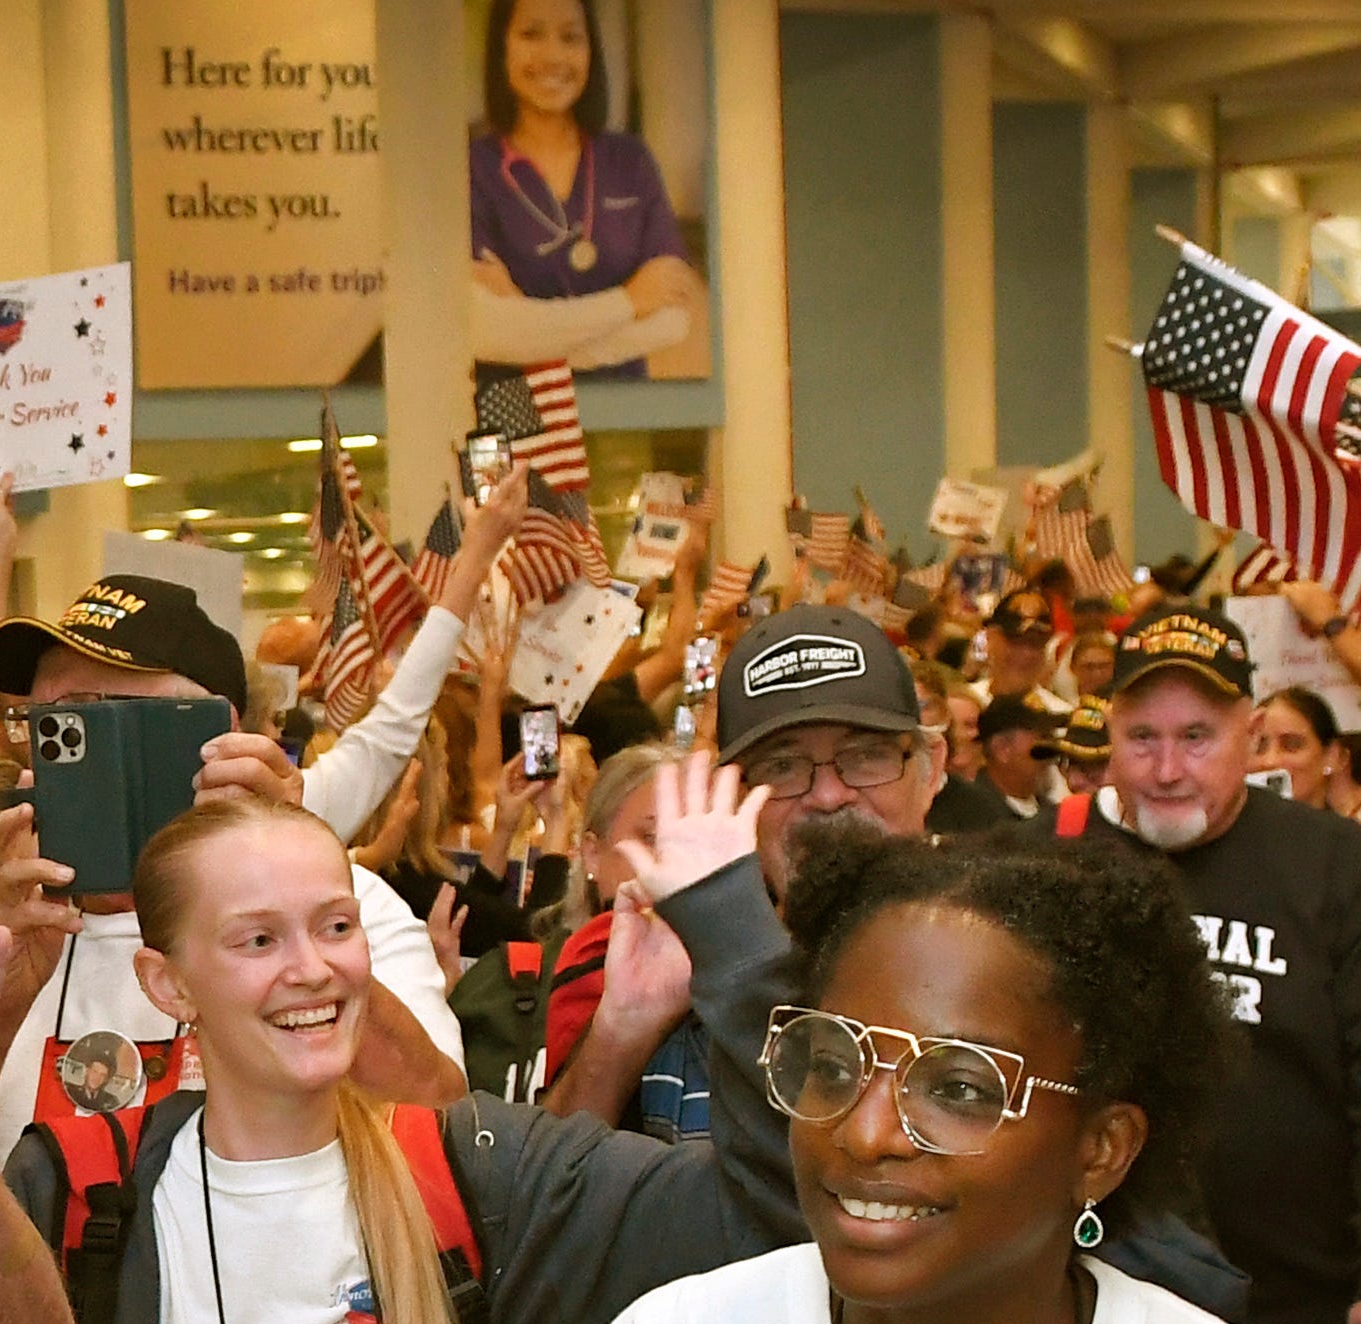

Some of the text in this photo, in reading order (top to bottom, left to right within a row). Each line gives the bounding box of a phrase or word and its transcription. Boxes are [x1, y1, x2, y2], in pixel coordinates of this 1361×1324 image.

[159, 46, 251, 88] Here
[261, 46, 313, 89] for
[161, 114, 324, 153] wherever
[166, 181, 342, 233] takes you.
[168, 268, 236, 294] Have
[244, 275, 260, 293] a
[268, 265, 322, 293] safe
[18, 362, 52, 387] You
[9, 399, 80, 427] Service
[750, 651, 799, 682] HARBOR
[799, 647, 856, 663] FREIGHT
